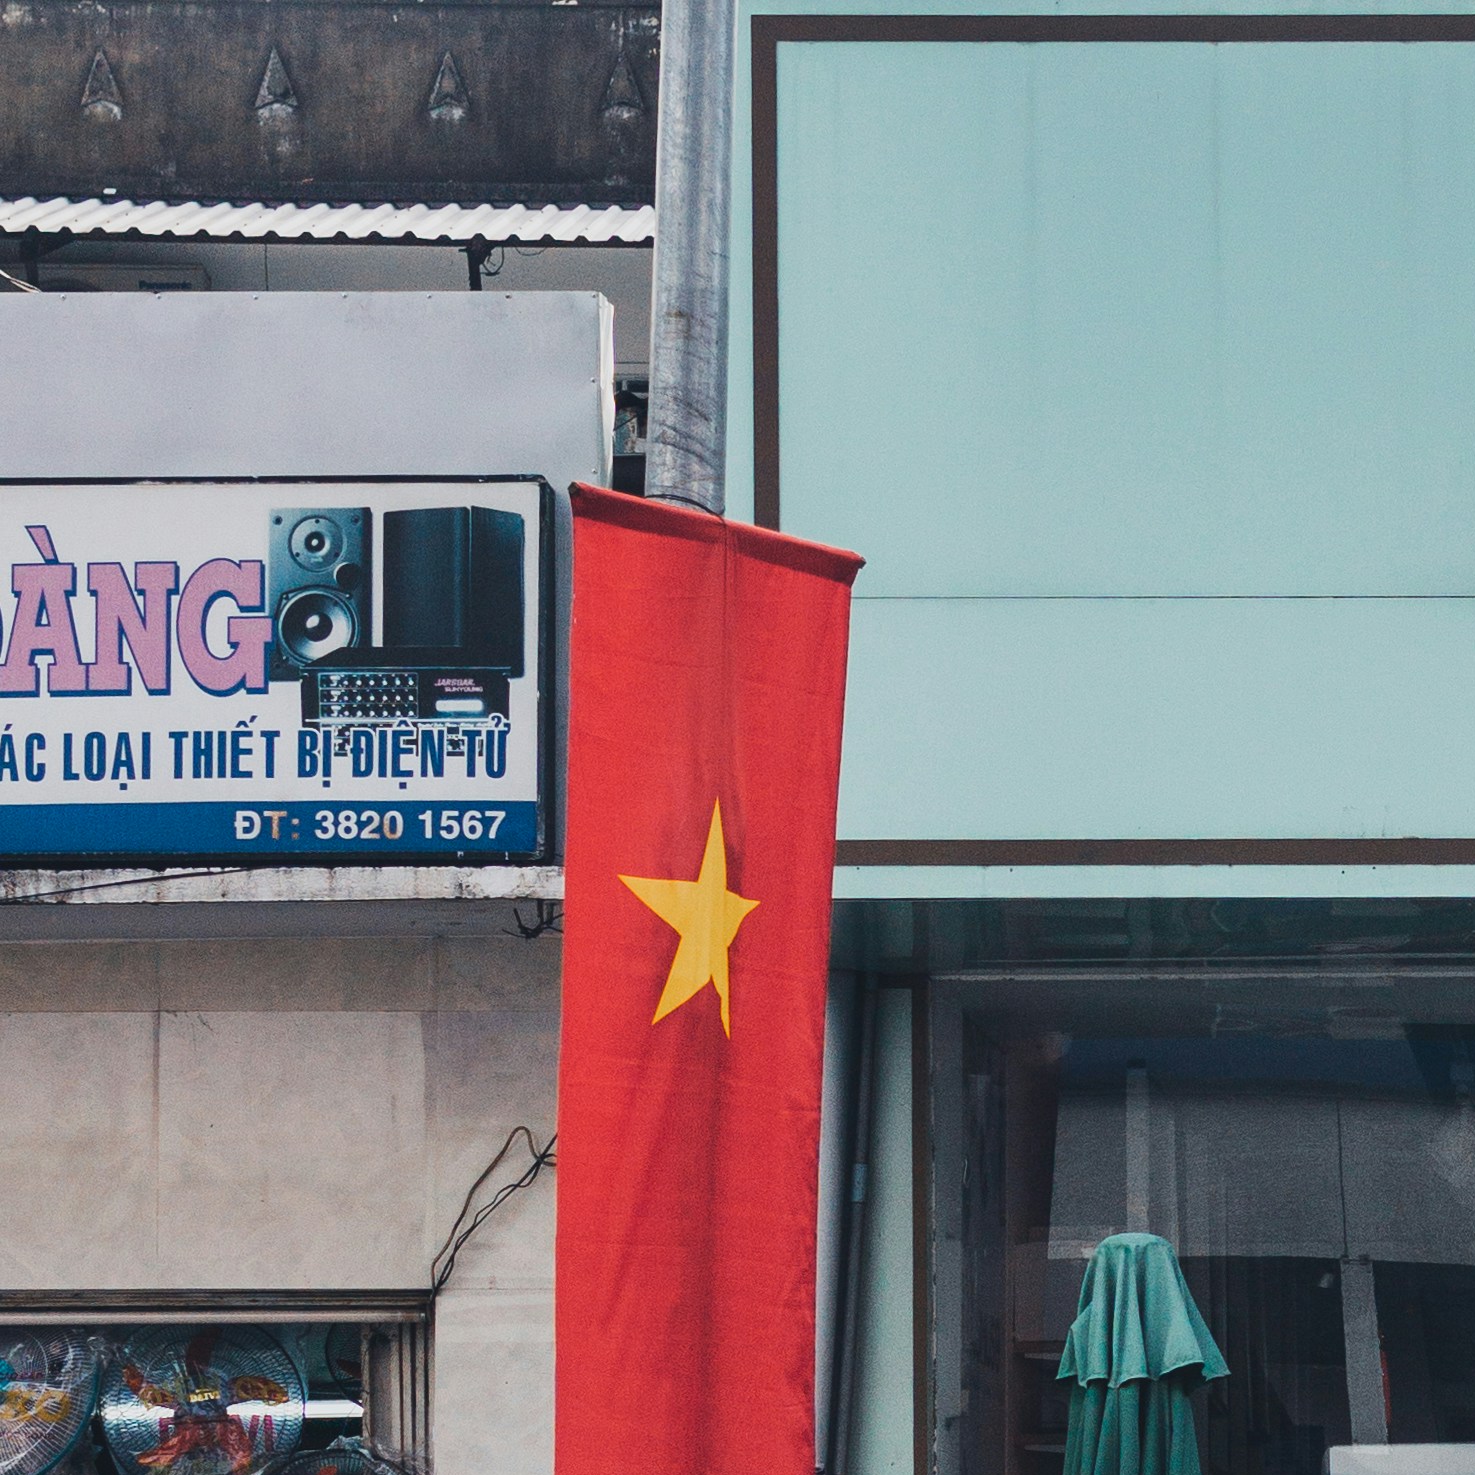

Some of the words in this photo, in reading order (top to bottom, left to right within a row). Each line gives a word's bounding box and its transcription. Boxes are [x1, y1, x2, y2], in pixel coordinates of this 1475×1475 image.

[0, 525, 274, 696] ÀNG
[63, 731, 151, 790] LOẠI
[169, 715, 281, 779] THIẾT
[299, 729, 332, 788] BỊ
[352, 719, 445, 789] ĐIỆN
[461, 715, 511, 779] TỬ
[234, 811, 300, 840] ĐT:
[315, 810, 404, 840] 3820
[418, 810, 506, 840] 1567
